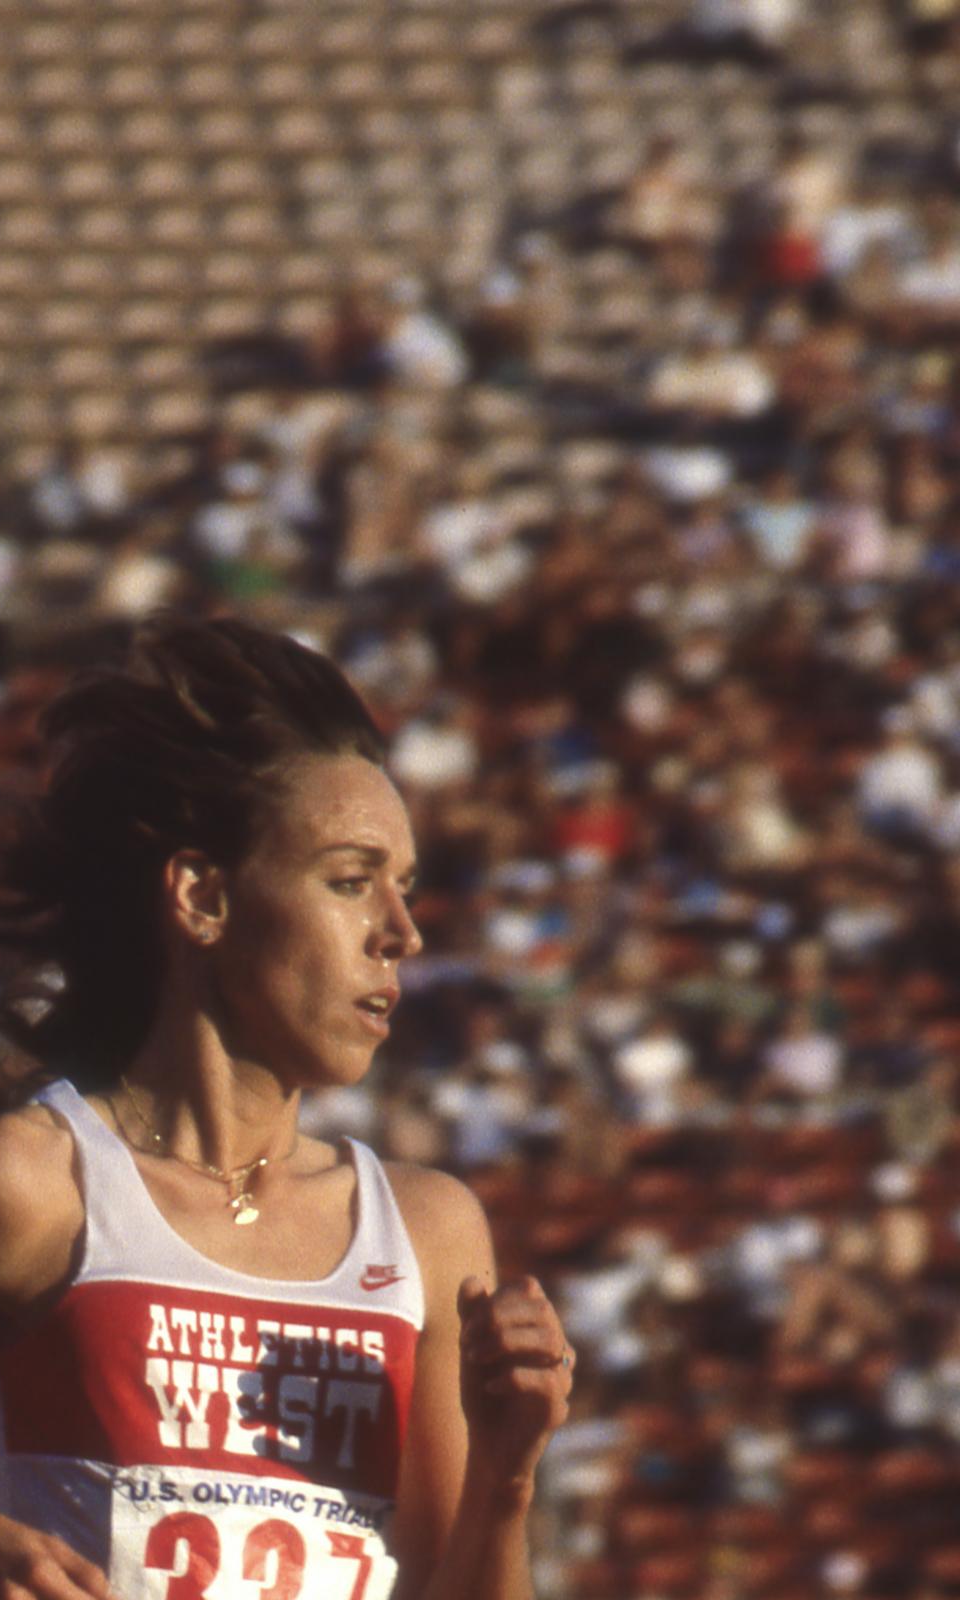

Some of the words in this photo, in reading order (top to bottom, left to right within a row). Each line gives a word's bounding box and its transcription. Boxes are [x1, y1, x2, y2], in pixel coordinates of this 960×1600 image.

[147, 1303, 386, 1374] ATHLETICS
[145, 1357, 383, 1468] WEST
[129, 1479, 184, 1503] U.S.
[192, 1482, 306, 1513] OLYMPIC
